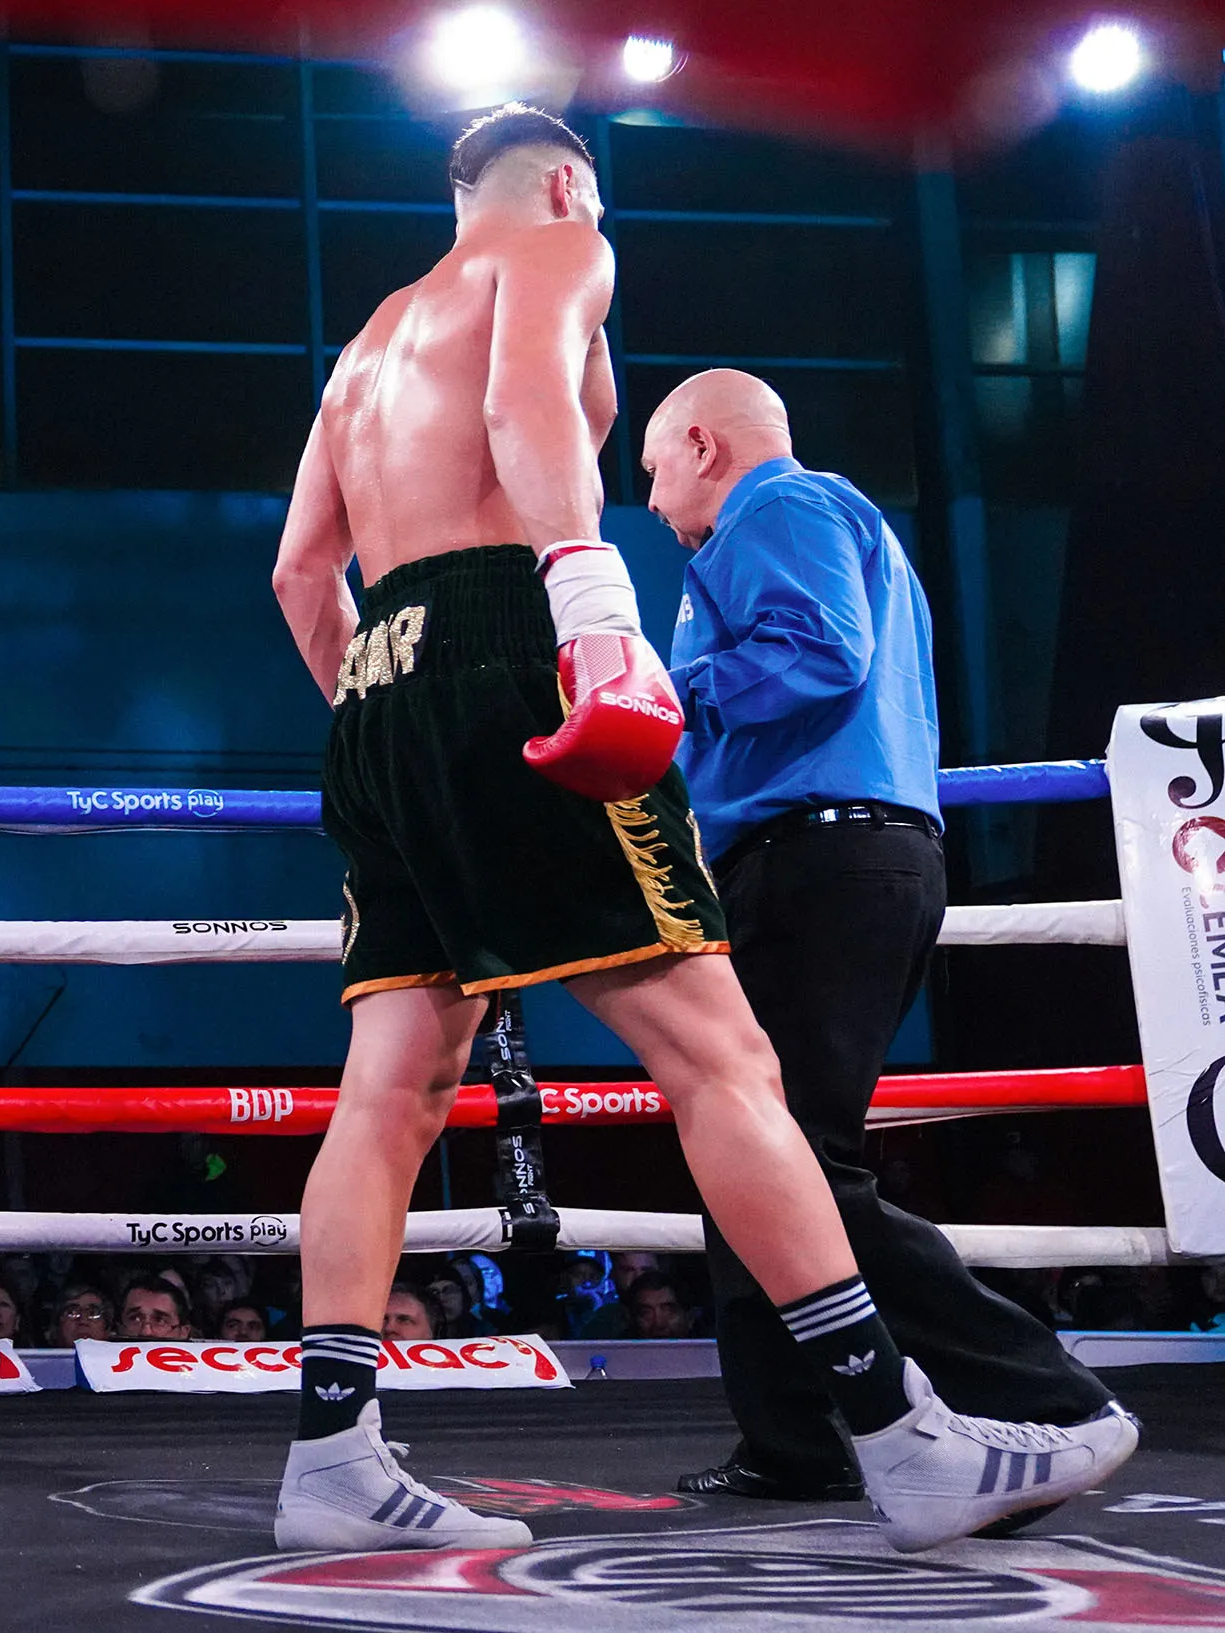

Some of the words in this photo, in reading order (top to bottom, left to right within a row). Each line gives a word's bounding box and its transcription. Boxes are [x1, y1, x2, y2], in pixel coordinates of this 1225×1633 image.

[600, 691, 680, 725] SONNOS
[66, 790, 109, 815] TyC
[111, 791, 183, 815] Sports
[188, 792, 224, 811] play
[172, 920, 289, 935] SONNOS
[1181, 886, 1200, 960] Evaluaciones
[228, 1088, 294, 1122] BDP
[564, 1087, 661, 1118] Sports
[125, 1222, 168, 1247] TyC
[172, 1222, 245, 1246] Sports
[250, 1222, 287, 1241] play
